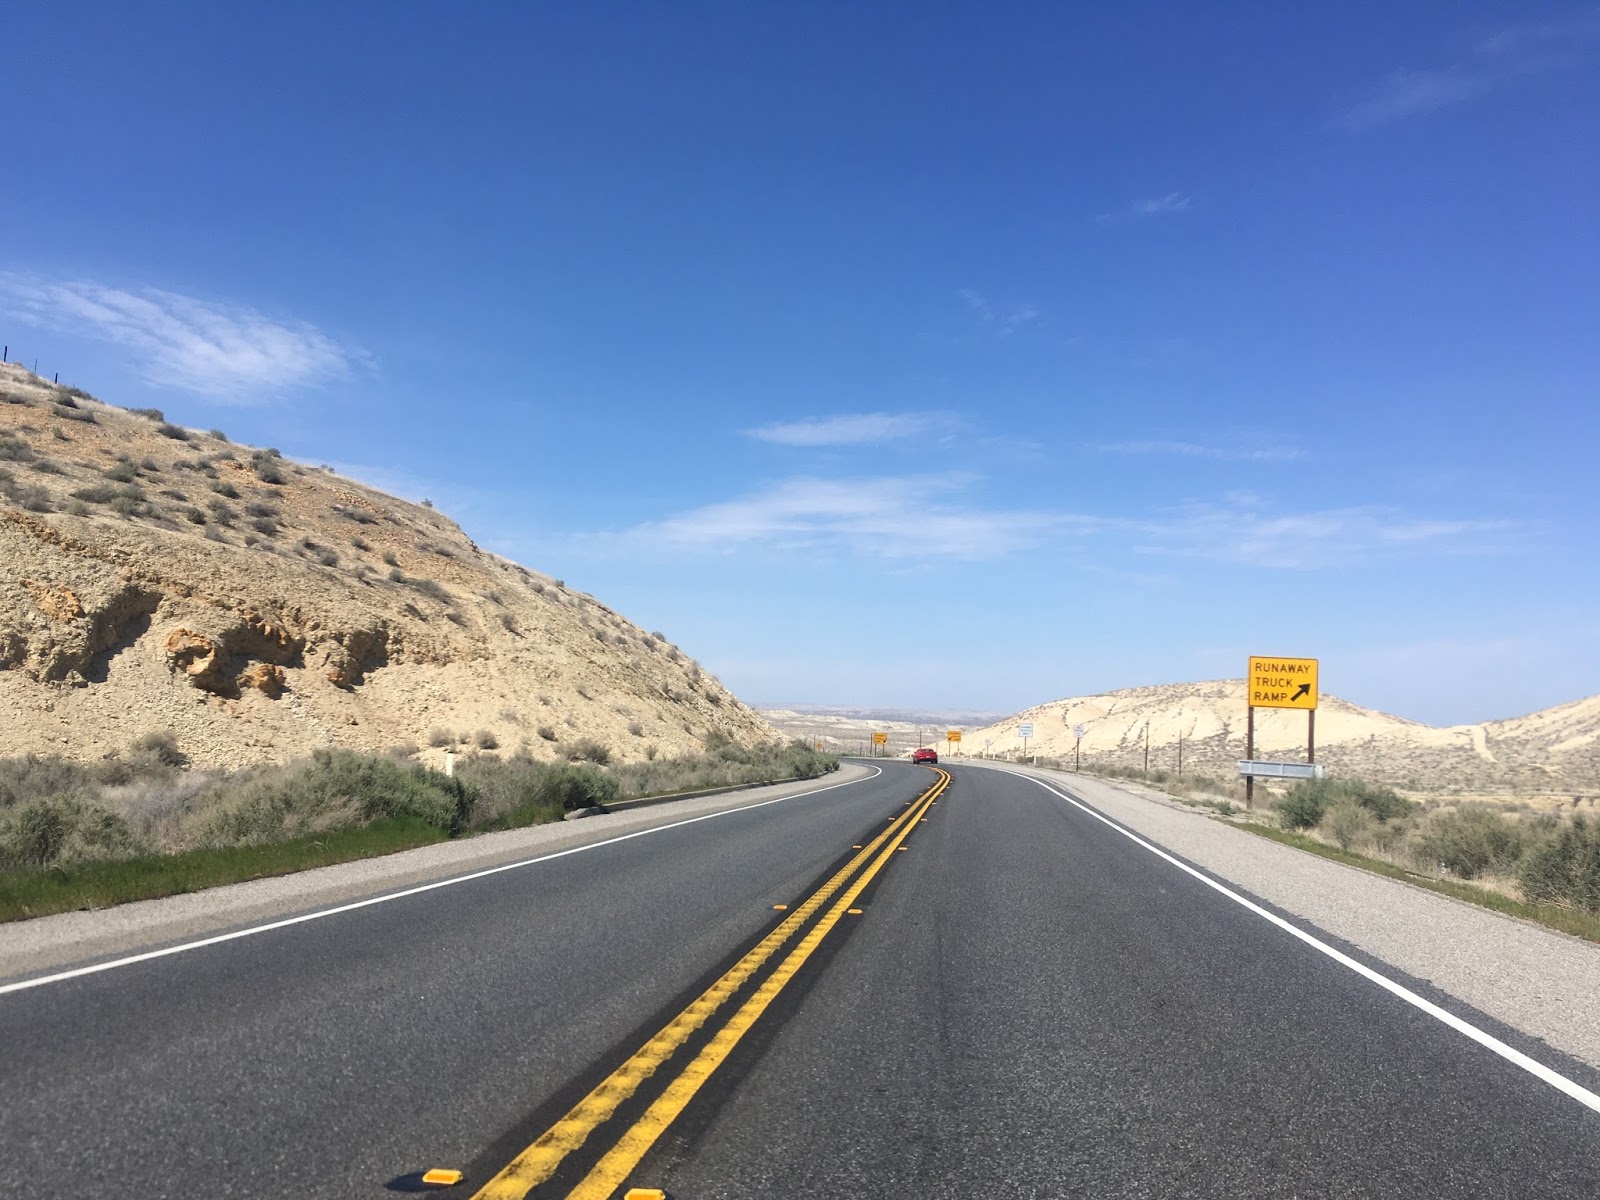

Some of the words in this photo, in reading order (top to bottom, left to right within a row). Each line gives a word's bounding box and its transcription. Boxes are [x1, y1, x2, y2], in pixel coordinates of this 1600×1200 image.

[1255, 663, 1311, 674] RUNAWAY
[1255, 677, 1293, 688] TRUCK
[1254, 691, 1288, 702] RAMP
